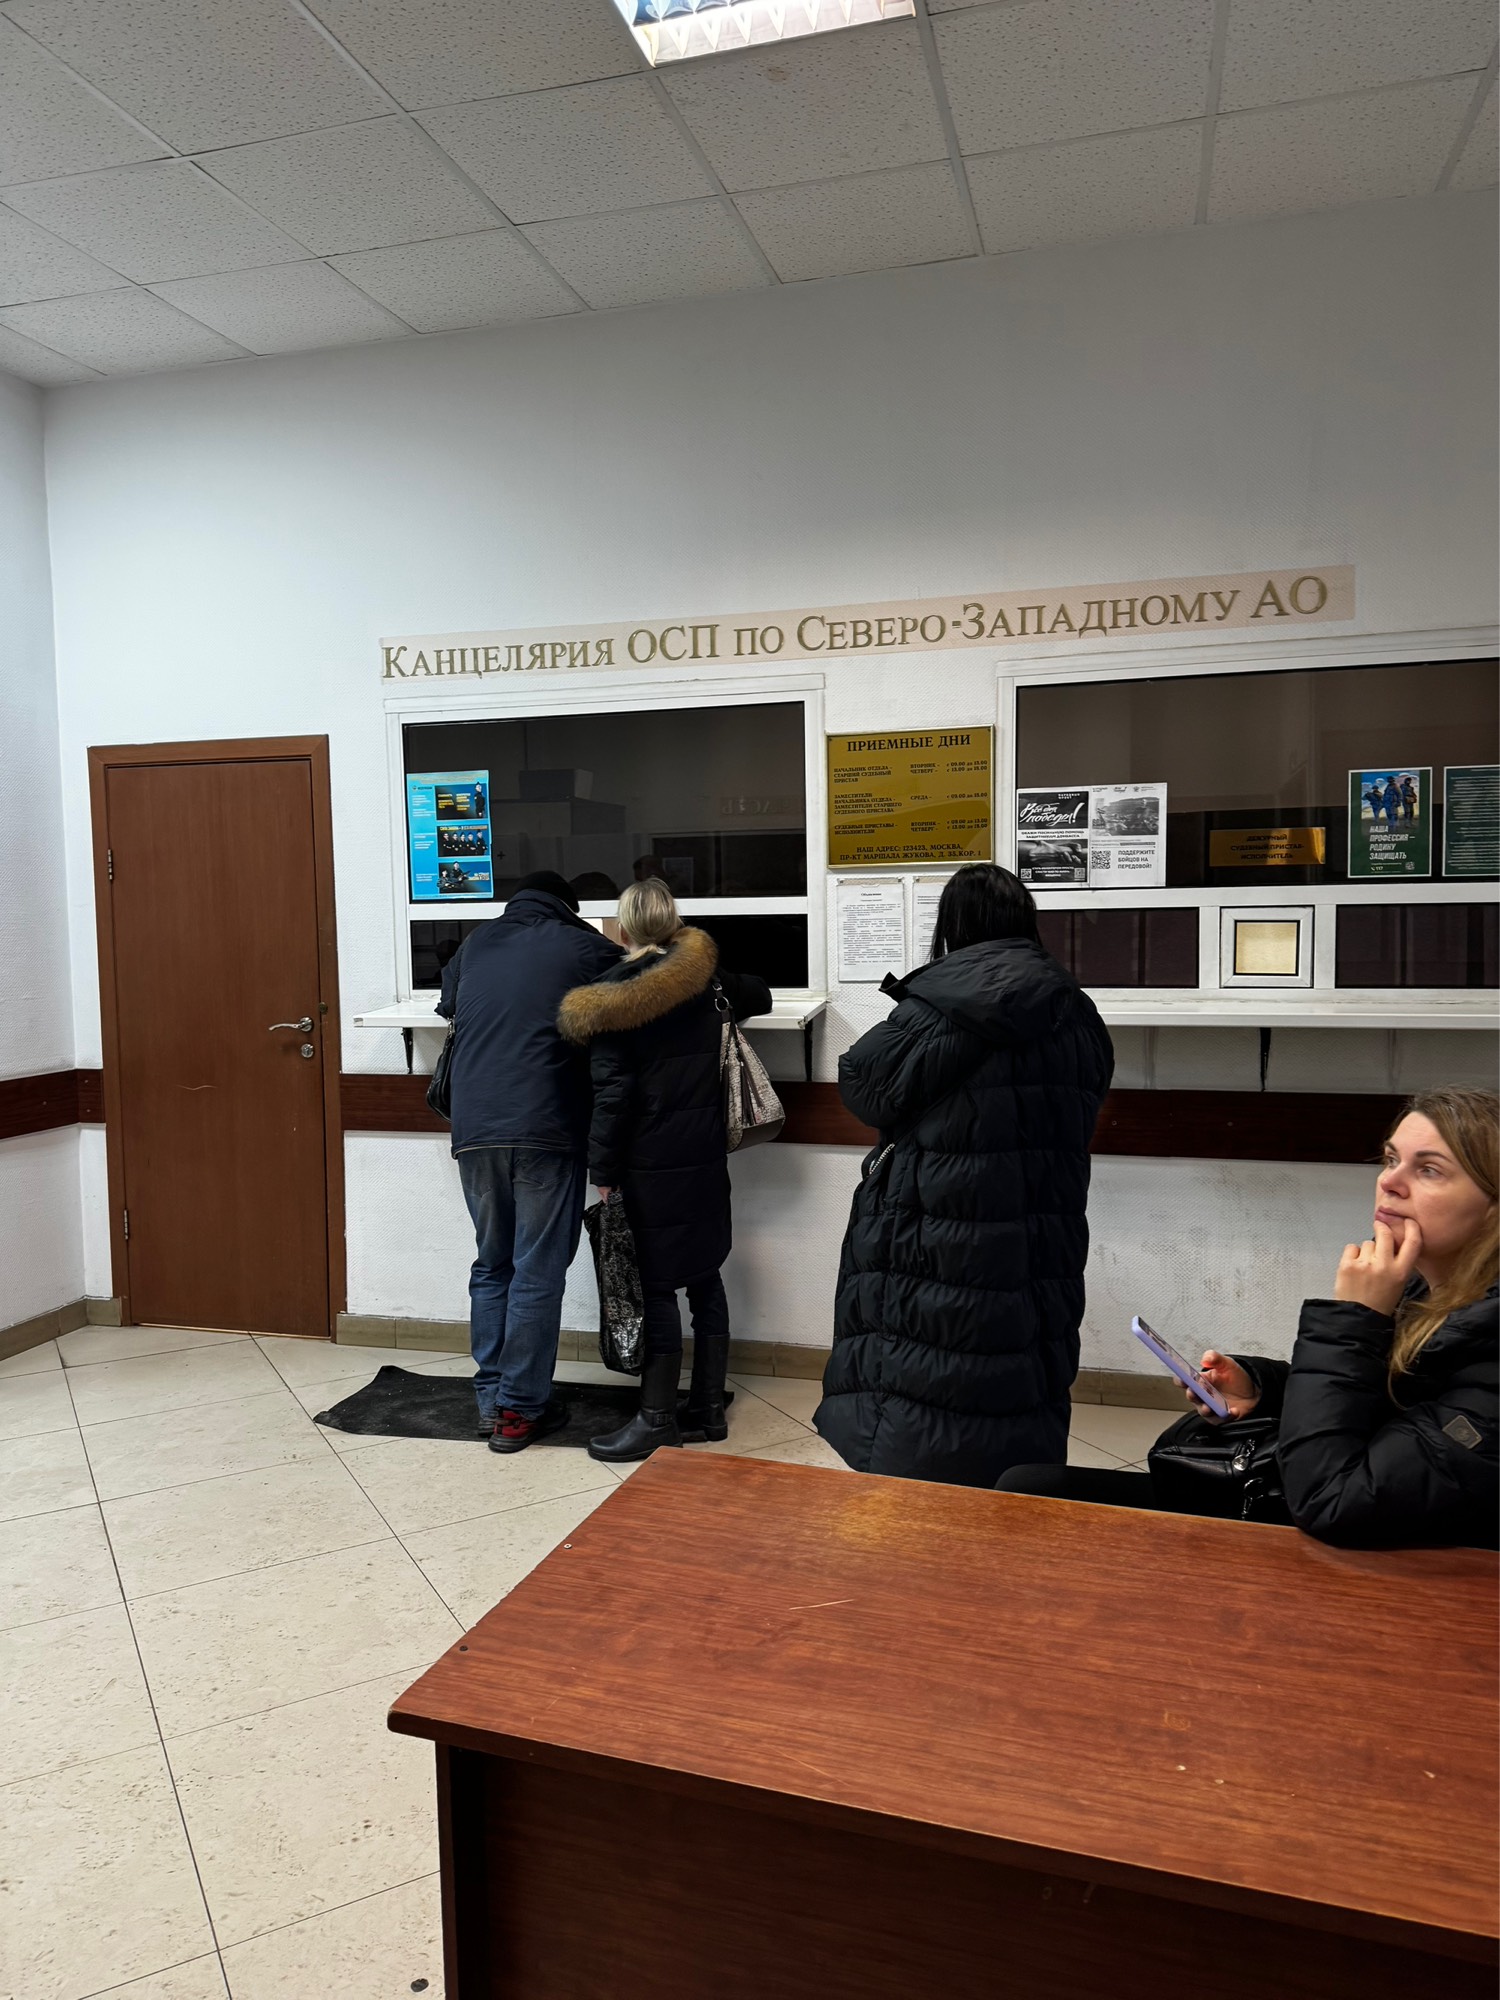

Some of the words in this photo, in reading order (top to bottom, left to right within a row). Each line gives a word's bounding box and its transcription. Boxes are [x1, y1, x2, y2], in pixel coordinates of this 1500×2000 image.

[382, 638, 616, 680] КАНЦЕЛЯРИЯ
[628, 624, 720, 664] ОСП
[1250, 575, 1329, 620] АО
[847, 736, 934, 752] ПРИЕМНЫЕ
[937, 734, 971, 748] ДНИ
[1369, 825, 1389, 833] НАША
[1369, 834, 1409, 842] ПРОФЕССИЯ
[1230, 843, 1269, 851] СУДЕБНЫЙ
[1369, 843, 1397, 851] РОДИНУ
[1241, 852, 1293, 860] ИСПОЛНИТЕЛЬ
[1369, 851, 1407, 861] ЗАЩИЩАТЬ
